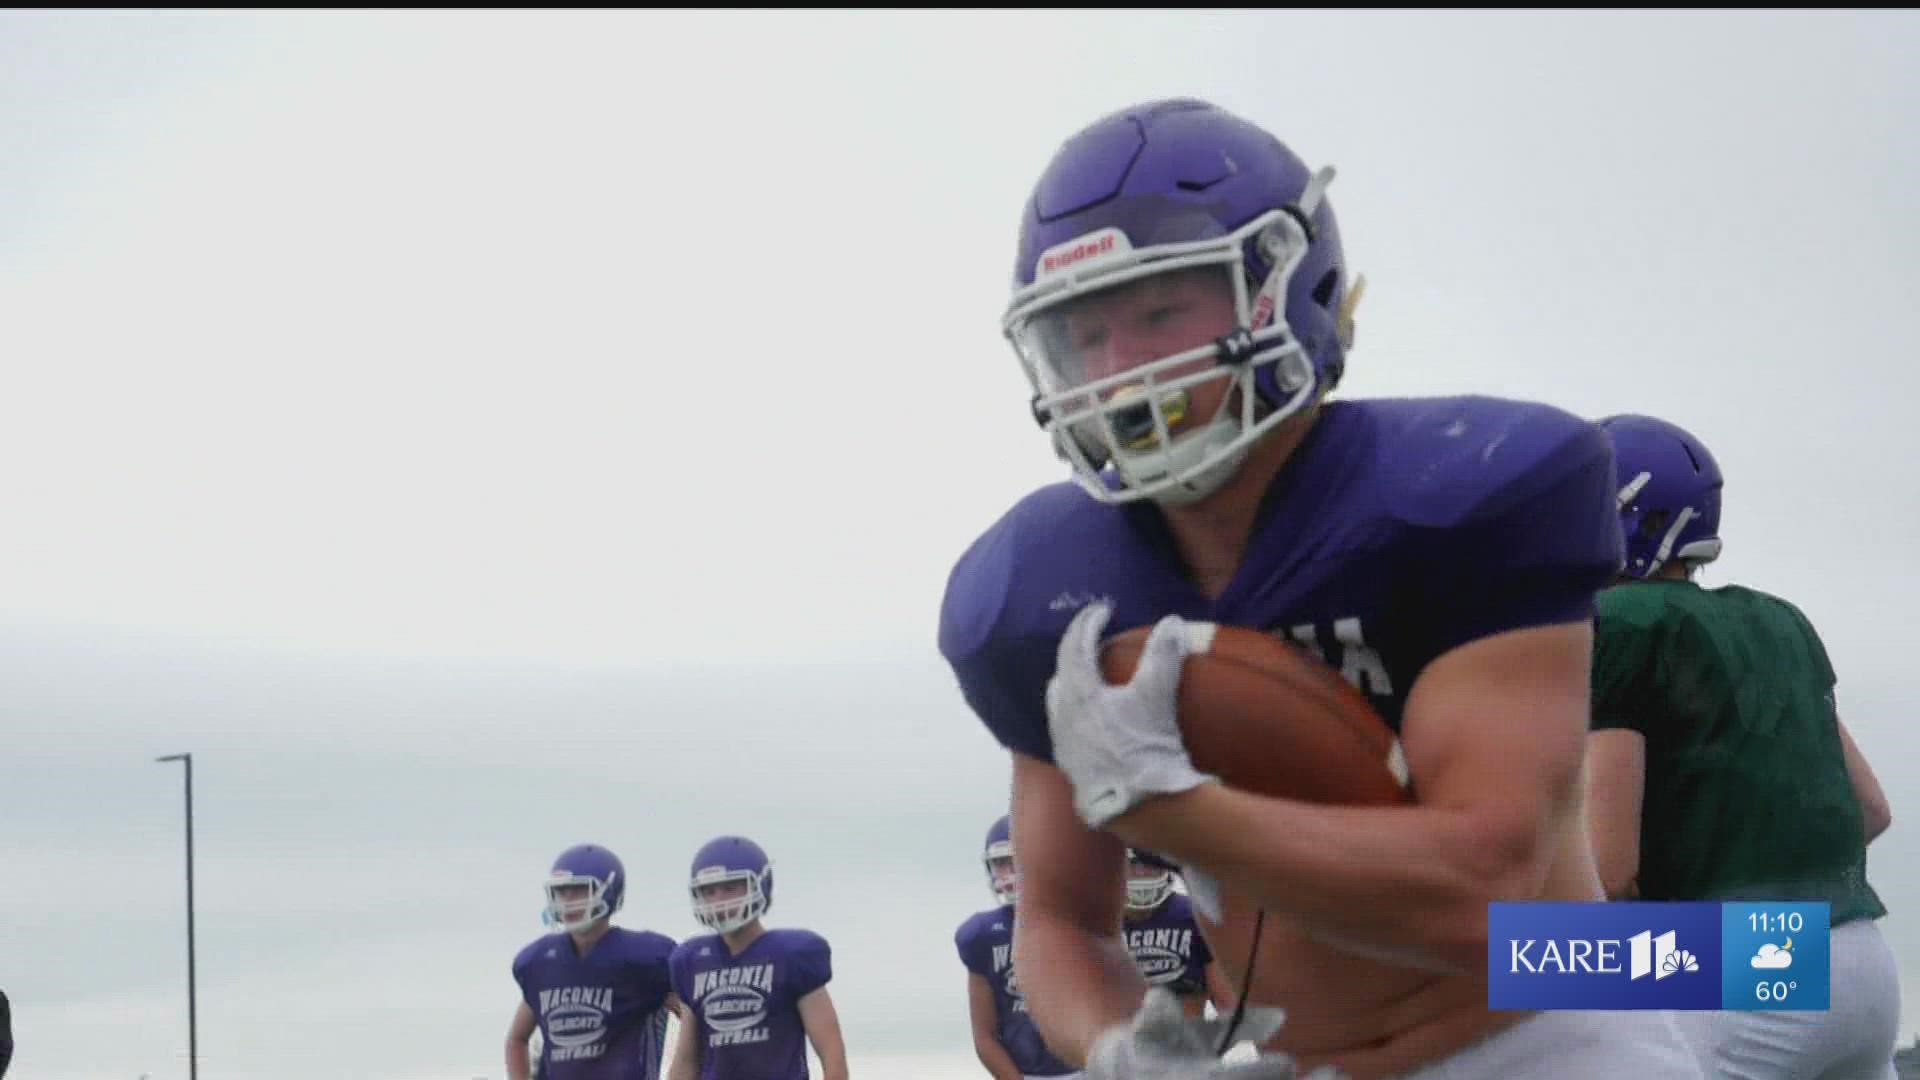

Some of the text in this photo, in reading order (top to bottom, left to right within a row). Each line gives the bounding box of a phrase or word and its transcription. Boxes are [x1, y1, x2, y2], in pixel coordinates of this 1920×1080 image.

[1120, 928, 1192, 958] ACONIA
[693, 964, 774, 1000] WACONIA
[539, 986, 613, 1014] WACONIA
